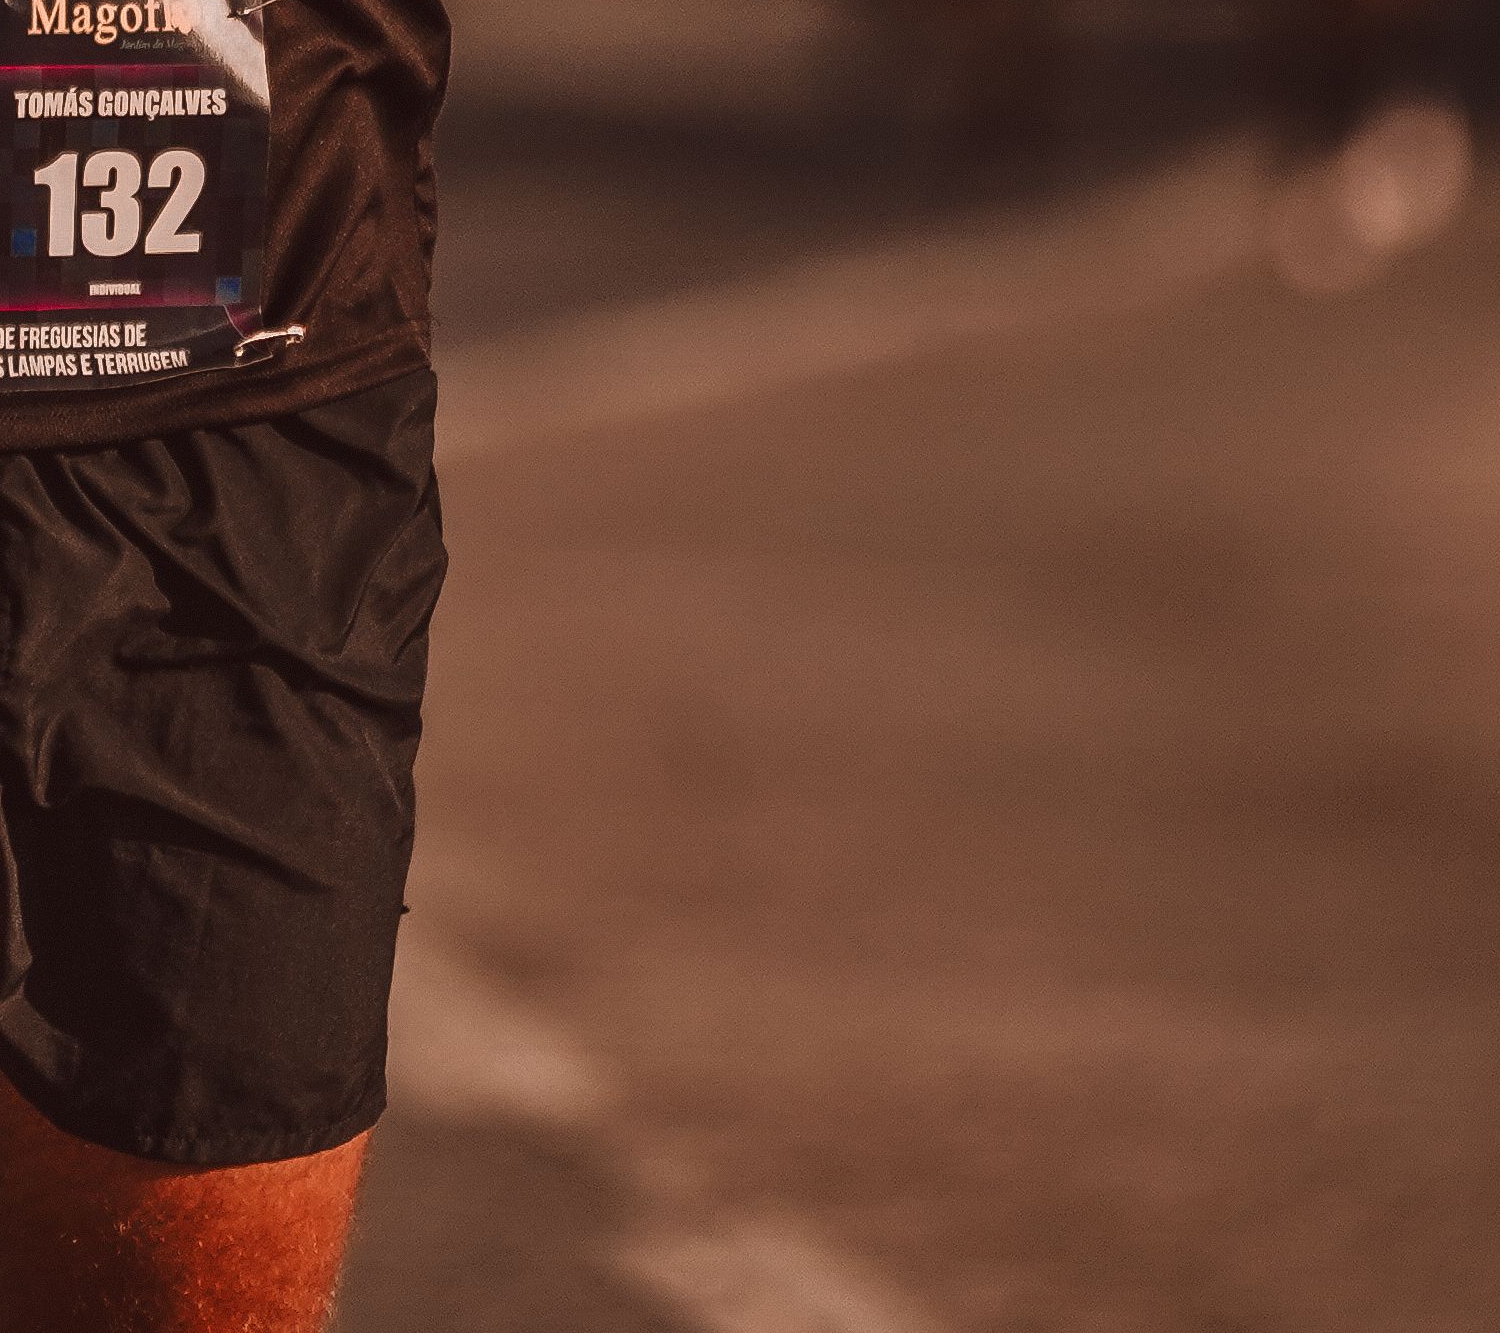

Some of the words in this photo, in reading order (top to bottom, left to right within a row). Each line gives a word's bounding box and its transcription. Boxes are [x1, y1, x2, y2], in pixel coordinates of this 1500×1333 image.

[14, 87, 94, 119] TOMÁS
[97, 88, 227, 121] GONÇALVES
[34, 149, 206, 257] 132
[89, 282, 142, 296] INDIVIDUAL
[19, 323, 121, 349] FREGUESIAS
[125, 322, 148, 347] DE
[7, 353, 76, 377] LAMPAS
[80, 354, 93, 375] E
[94, 349, 190, 376] TERRUGEM
